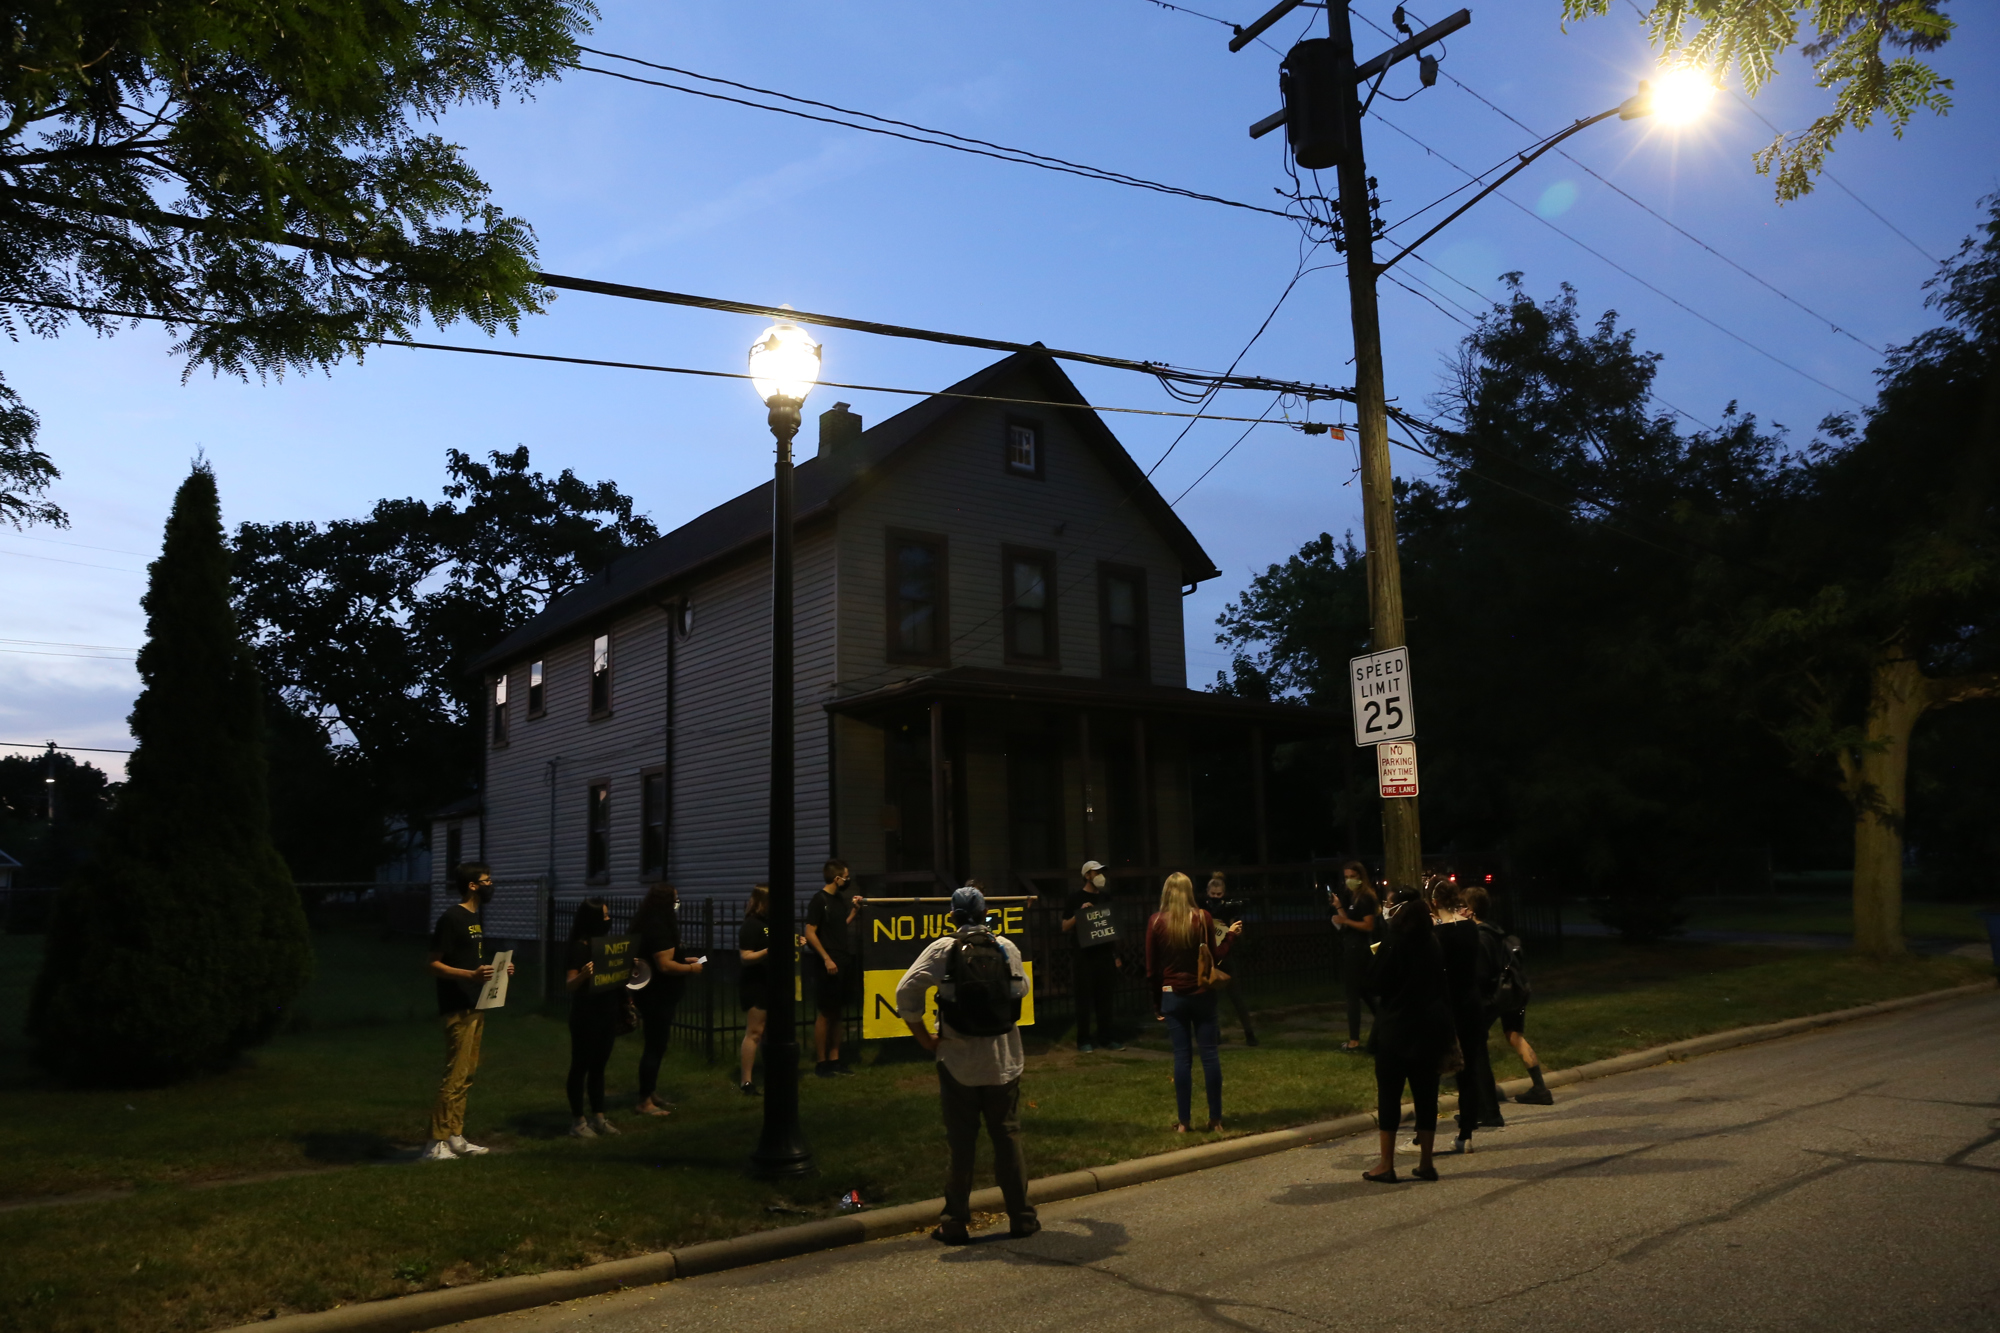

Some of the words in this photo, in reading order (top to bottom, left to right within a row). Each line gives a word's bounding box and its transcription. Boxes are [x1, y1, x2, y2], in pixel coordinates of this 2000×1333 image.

[1356, 659, 1403, 681] SPEED
[1361, 677, 1400, 698] LIMIT
[1363, 696, 1403, 734] 25
[1390, 745, 1403, 756] NO
[1381, 757, 1413, 767] PARKING
[1383, 768, 1397, 776] ANY
[1398, 767, 1413, 776] TIME
[1382, 786, 1397, 794] FIRE
[1398, 785, 1416, 793] LANE
[873, 915, 916, 943] NO
[919, 906, 1024, 940] JUSCE
[1093, 919, 1108, 928] THE
[1090, 926, 1116, 939] POLICE
